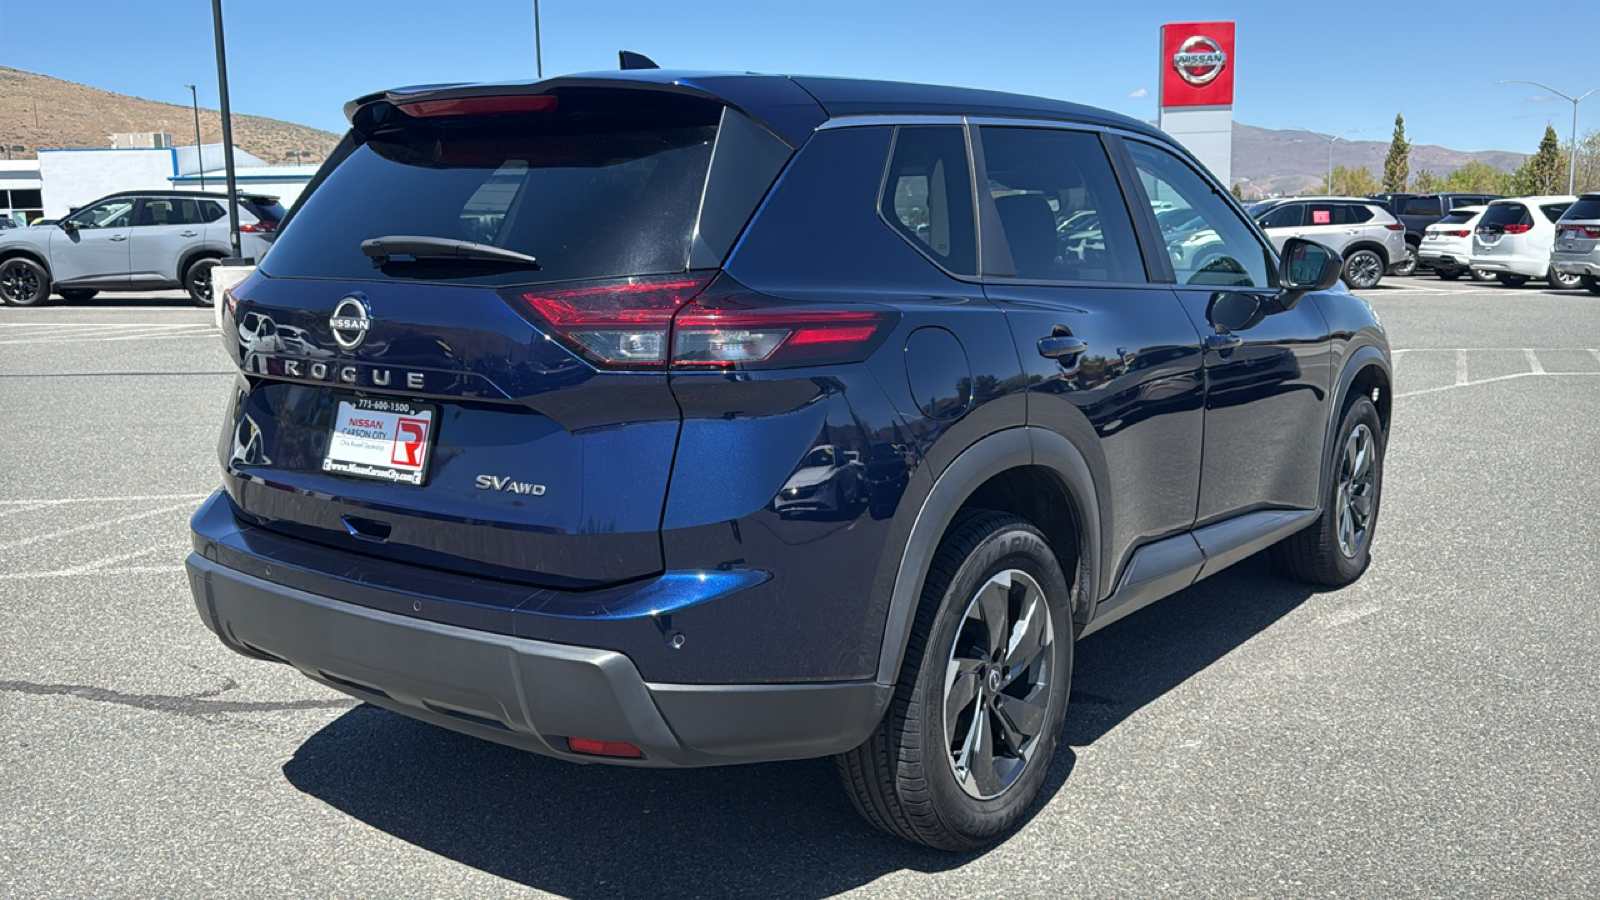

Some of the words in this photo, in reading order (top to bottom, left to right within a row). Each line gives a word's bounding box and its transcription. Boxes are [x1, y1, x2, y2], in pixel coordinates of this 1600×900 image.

[1178, 54, 1222, 63] NISSAN
[330, 318, 369, 330] NISSAN
[284, 359, 425, 389] ROGUE
[358, 399, 410, 412] 775-600-1500
[349, 418, 384, 430] NISSAN
[342, 427, 372, 440] CARSON
[372, 431, 388, 440] CITY
[475, 475, 510, 491] SV
[506, 481, 546, 496] AWD
